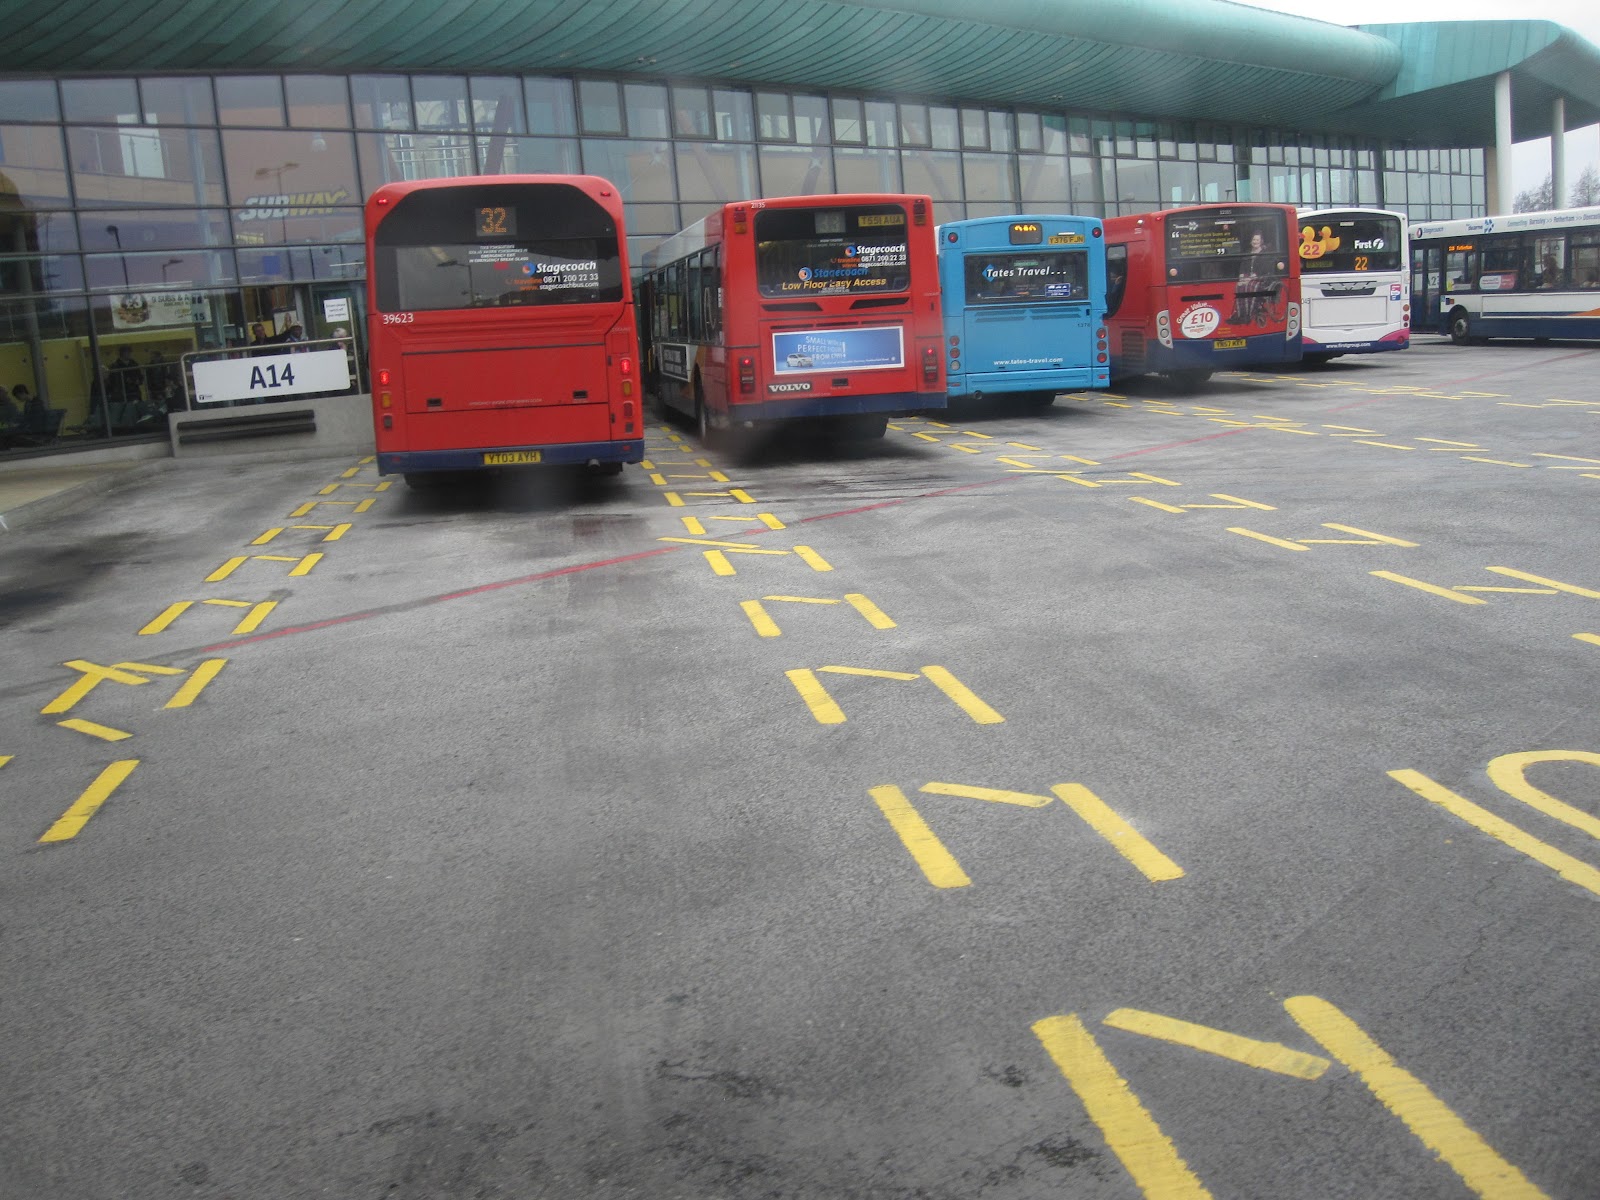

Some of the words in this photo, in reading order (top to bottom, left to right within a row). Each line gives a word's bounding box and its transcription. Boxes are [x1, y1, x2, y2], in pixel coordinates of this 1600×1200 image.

[238, 190, 348, 222] SUBWAY
[481, 207, 507, 233] 32
[1049, 236, 1068, 244] Y376
[1354, 239, 1372, 250] First
[856, 244, 906, 255] Stagecoach
[1303, 244, 1320, 256] 22
[877, 254, 889, 262] 200
[889, 254, 898, 262] 22
[898, 253, 907, 261] 33
[1354, 256, 1368, 271] 22
[536, 261, 597, 275] Stagecoach
[813, 267, 869, 278] Stagecoach
[986, 267, 1014, 278] Tates
[543, 275, 561, 284] 0871
[563, 274, 577, 283] 200
[578, 274, 588, 282] 22
[589, 273, 599, 281] 33
[782, 282, 802, 290] Low
[803, 281, 828, 289] Floor
[829, 279, 852, 289] Easy
[853, 278, 887, 286] Access
[382, 313, 414, 325] 39623
[1176, 307, 1191, 324] Great
[1191, 311, 1214, 325] £10
[993, 357, 1064, 366] www.tates-travel.com
[249, 362, 296, 390] A14
[768, 382, 811, 393] VOLVO
[488, 454, 515, 464] YT03
[517, 451, 537, 462] AYH
